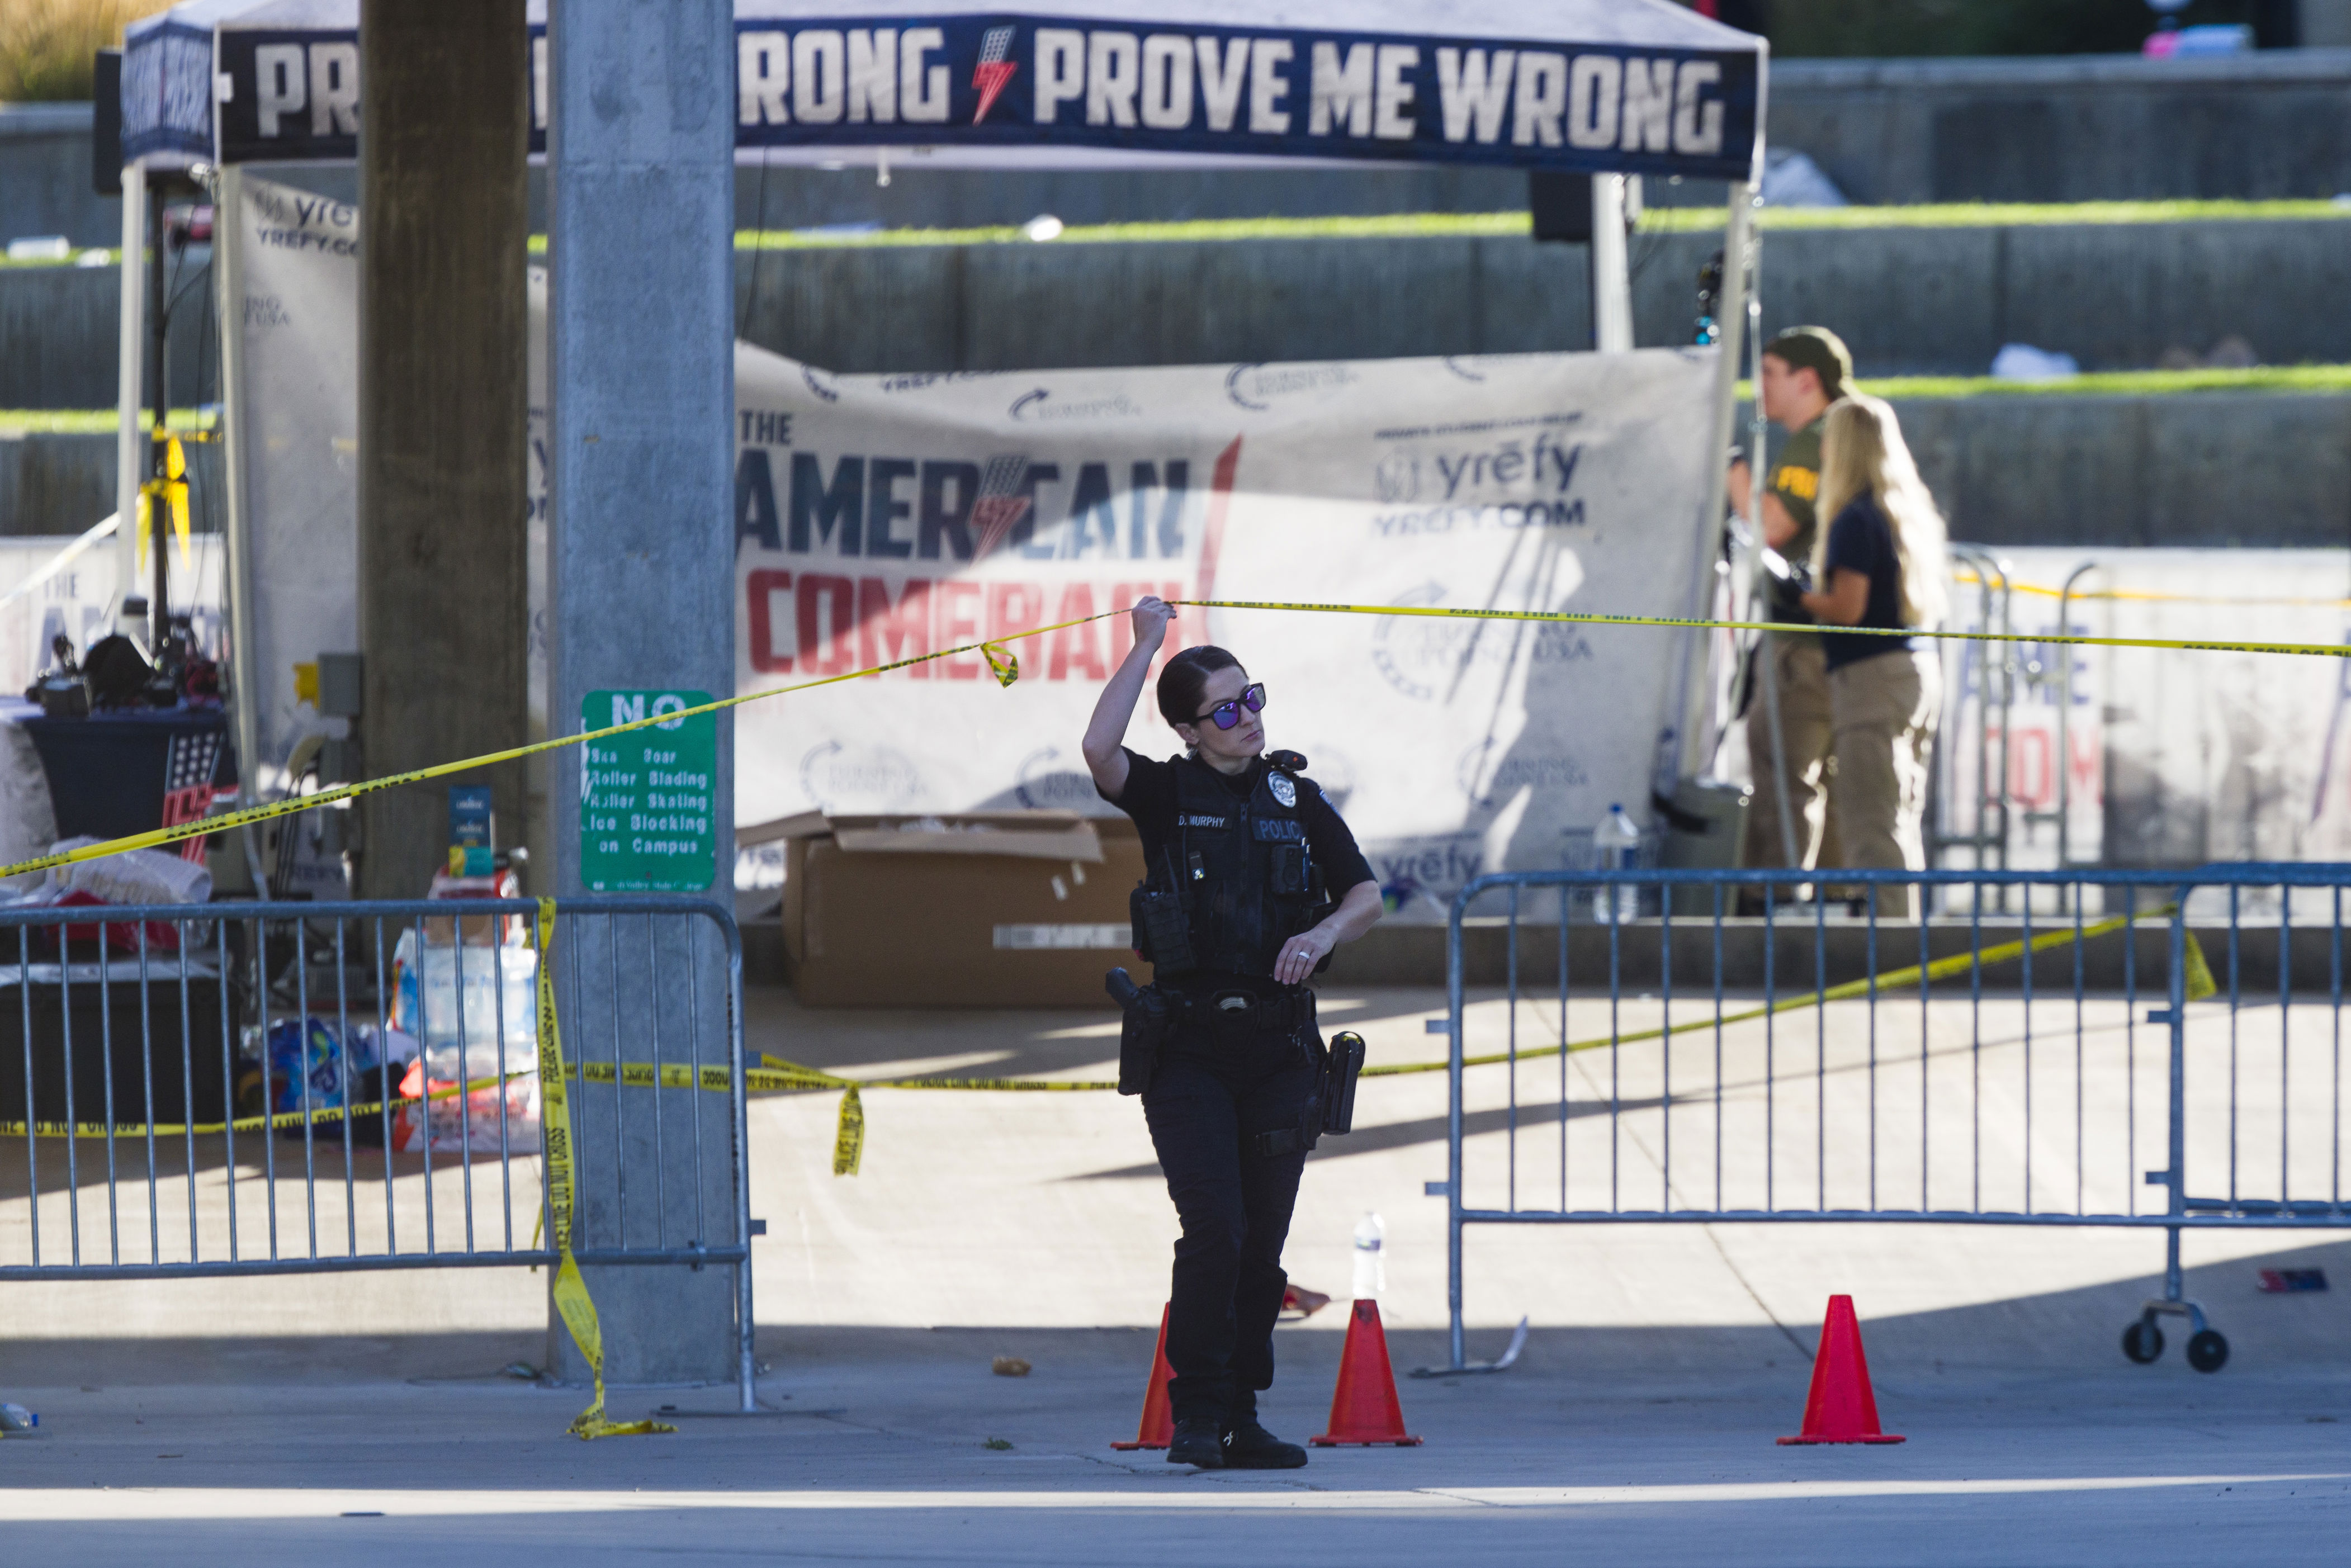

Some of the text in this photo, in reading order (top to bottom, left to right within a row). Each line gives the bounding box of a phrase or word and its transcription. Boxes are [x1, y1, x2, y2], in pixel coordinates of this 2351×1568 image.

[737, 27, 950, 125] RONG
[1034, 27, 1294, 134] PROVE
[1309, 41, 1419, 140] ME
[1436, 47, 1724, 155] WRONG
[738, 408, 792, 446] THE
[611, 693, 687, 731] NO
[648, 770, 708, 790] Blading
[647, 792, 707, 813] Skating
[590, 813, 708, 835] Ice Blocking
[1178, 815, 1226, 828] D. MURPHY
[1259, 819, 1300, 840] POLIC
[599, 837, 698, 857] on Campus
